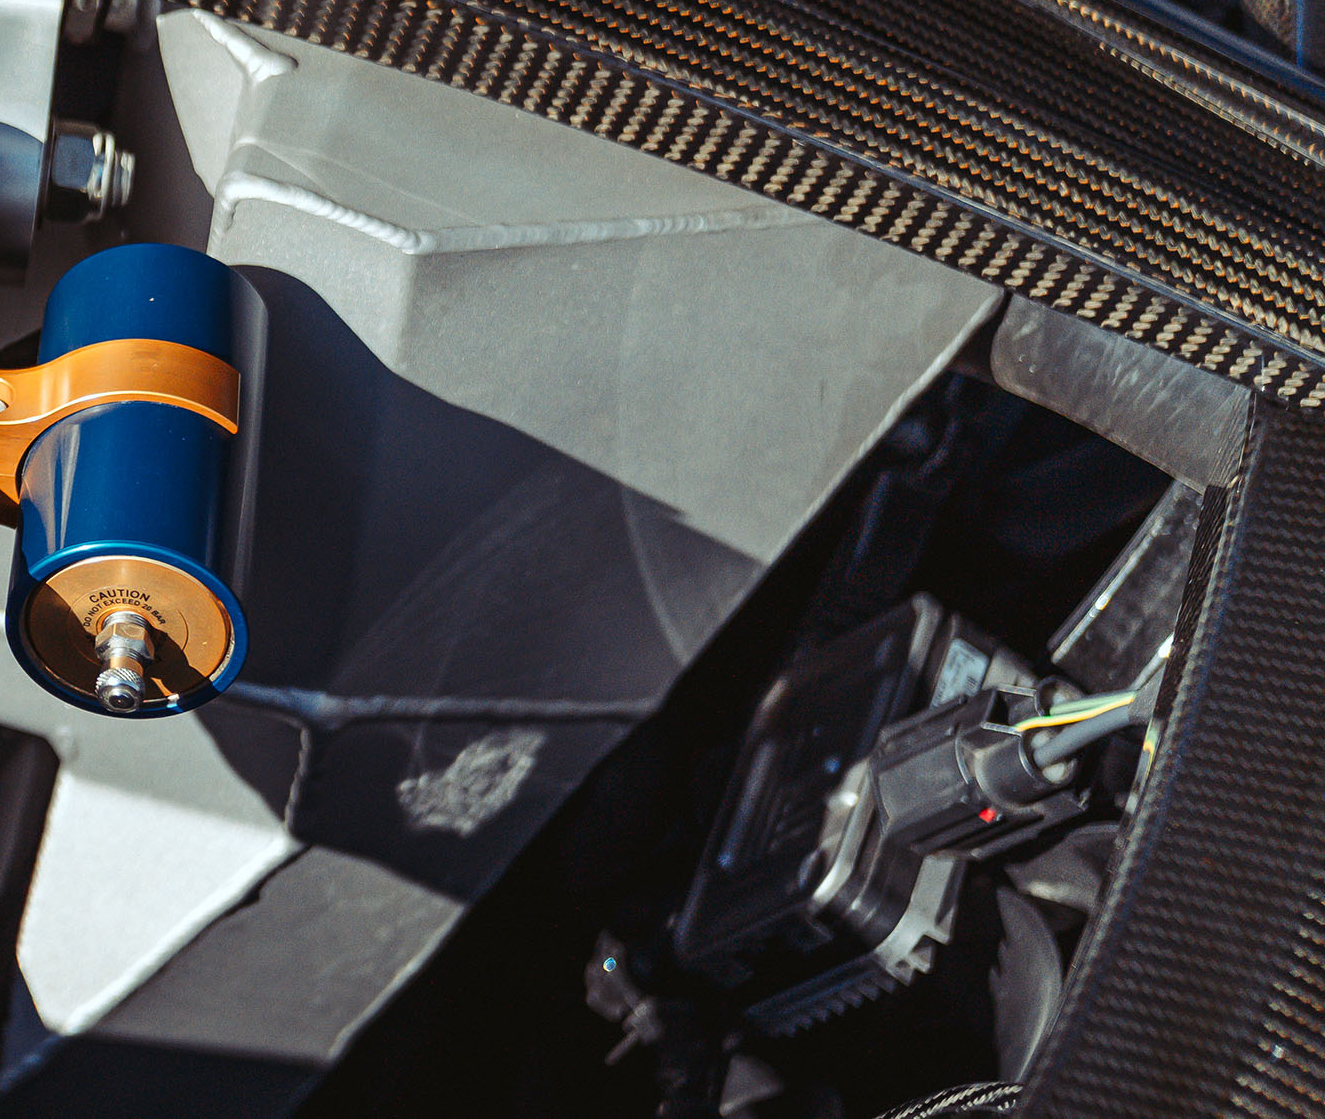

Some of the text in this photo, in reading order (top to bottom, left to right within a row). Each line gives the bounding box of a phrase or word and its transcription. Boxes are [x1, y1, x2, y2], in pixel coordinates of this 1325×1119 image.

[89, 589, 150, 603] CAUTION
[83, 616, 92, 627] DO
[88, 603, 102, 616] NOT
[103, 598, 141, 606] EXCEED
[152, 609, 166, 625] BAR
